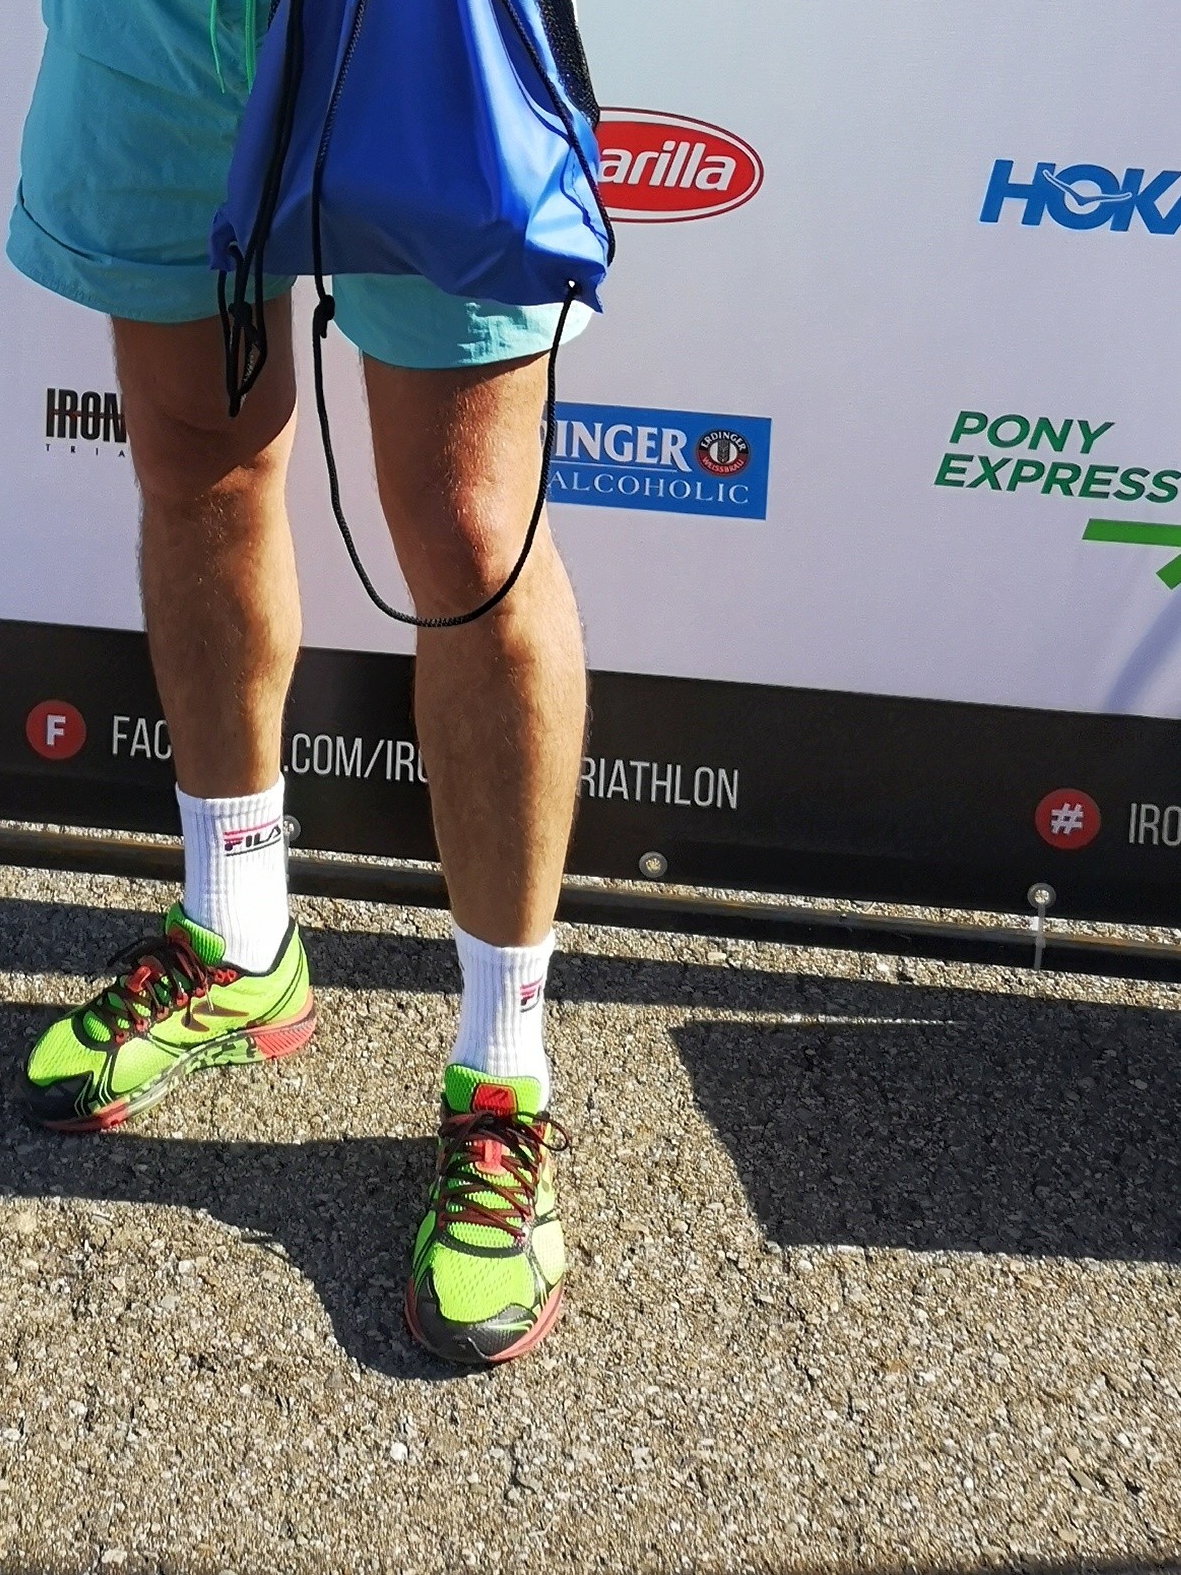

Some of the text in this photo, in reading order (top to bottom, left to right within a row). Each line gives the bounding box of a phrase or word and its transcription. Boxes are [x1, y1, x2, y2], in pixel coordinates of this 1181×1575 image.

[597, 140, 737, 191] arilla
[979, 159, 1181, 235] HOK
[46, 443, 125, 458] TRIA
[541, 420, 693, 473] INGER
[700, 431, 747, 451] ERDINGER
[949, 411, 1114, 455] PONY
[548, 469, 749, 505] ALCOHOLIC
[934, 454, 1181, 504] EXPRESS
[1128, 802, 1181, 847] IRO
